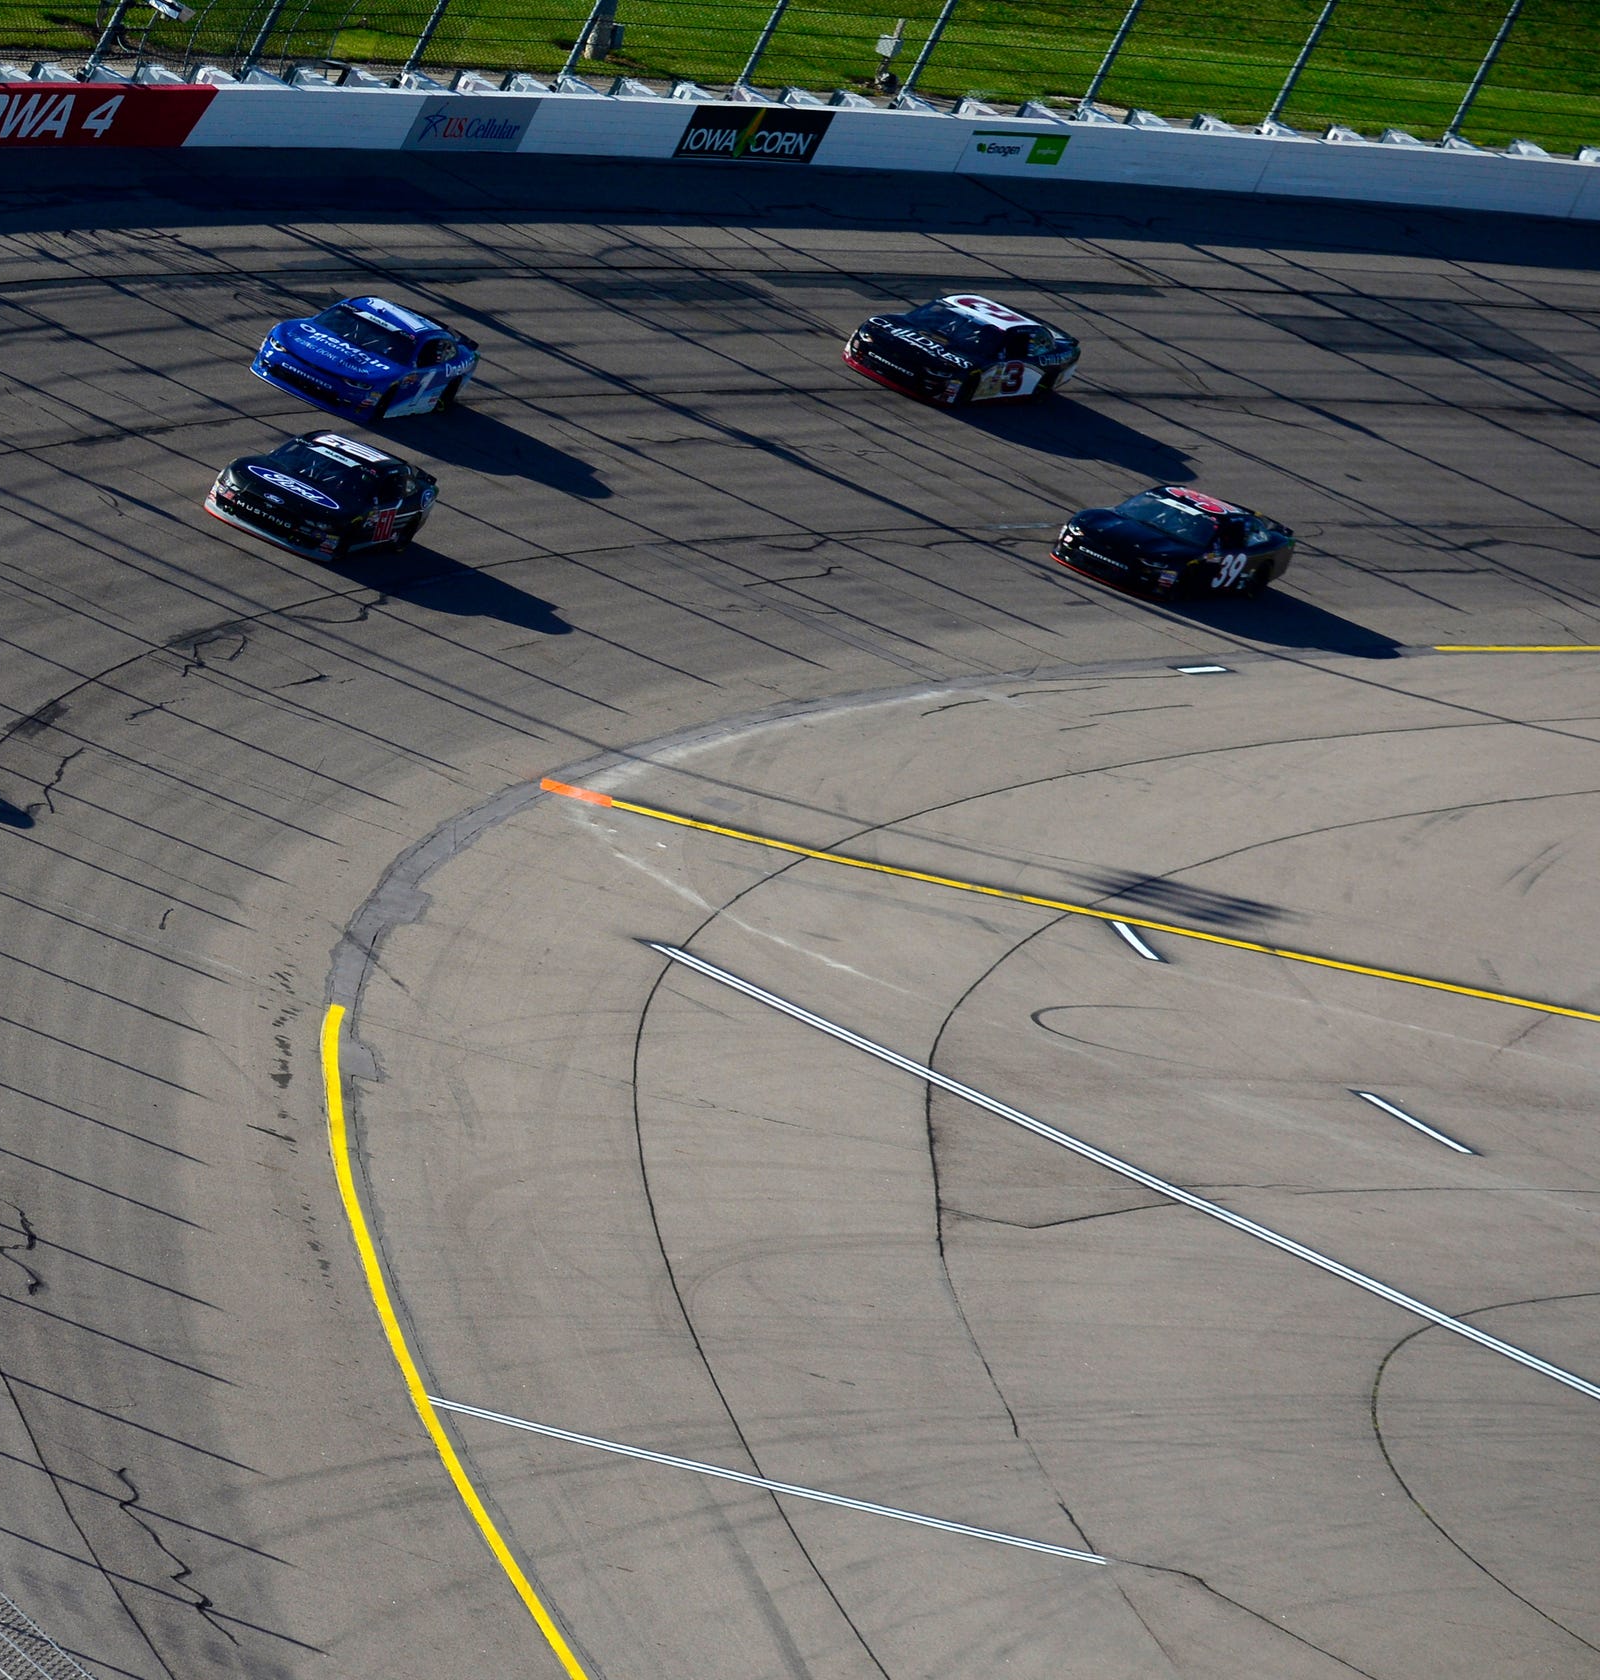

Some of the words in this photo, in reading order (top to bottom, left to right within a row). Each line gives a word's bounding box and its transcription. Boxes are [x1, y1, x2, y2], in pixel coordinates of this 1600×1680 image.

[82, 95, 125, 138] 4
[465, 118, 520, 139] Cellular
[683, 128, 738, 152] IOWA
[750, 131, 813, 155] CORN
[300, 323, 391, 371] OneMain
[868, 317, 974, 369] CHILDRESS
[1002, 360, 1025, 394] 3
[262, 473, 325, 502] Ford
[237, 499, 292, 529] MUSTANG
[1211, 553, 1247, 588] 39
